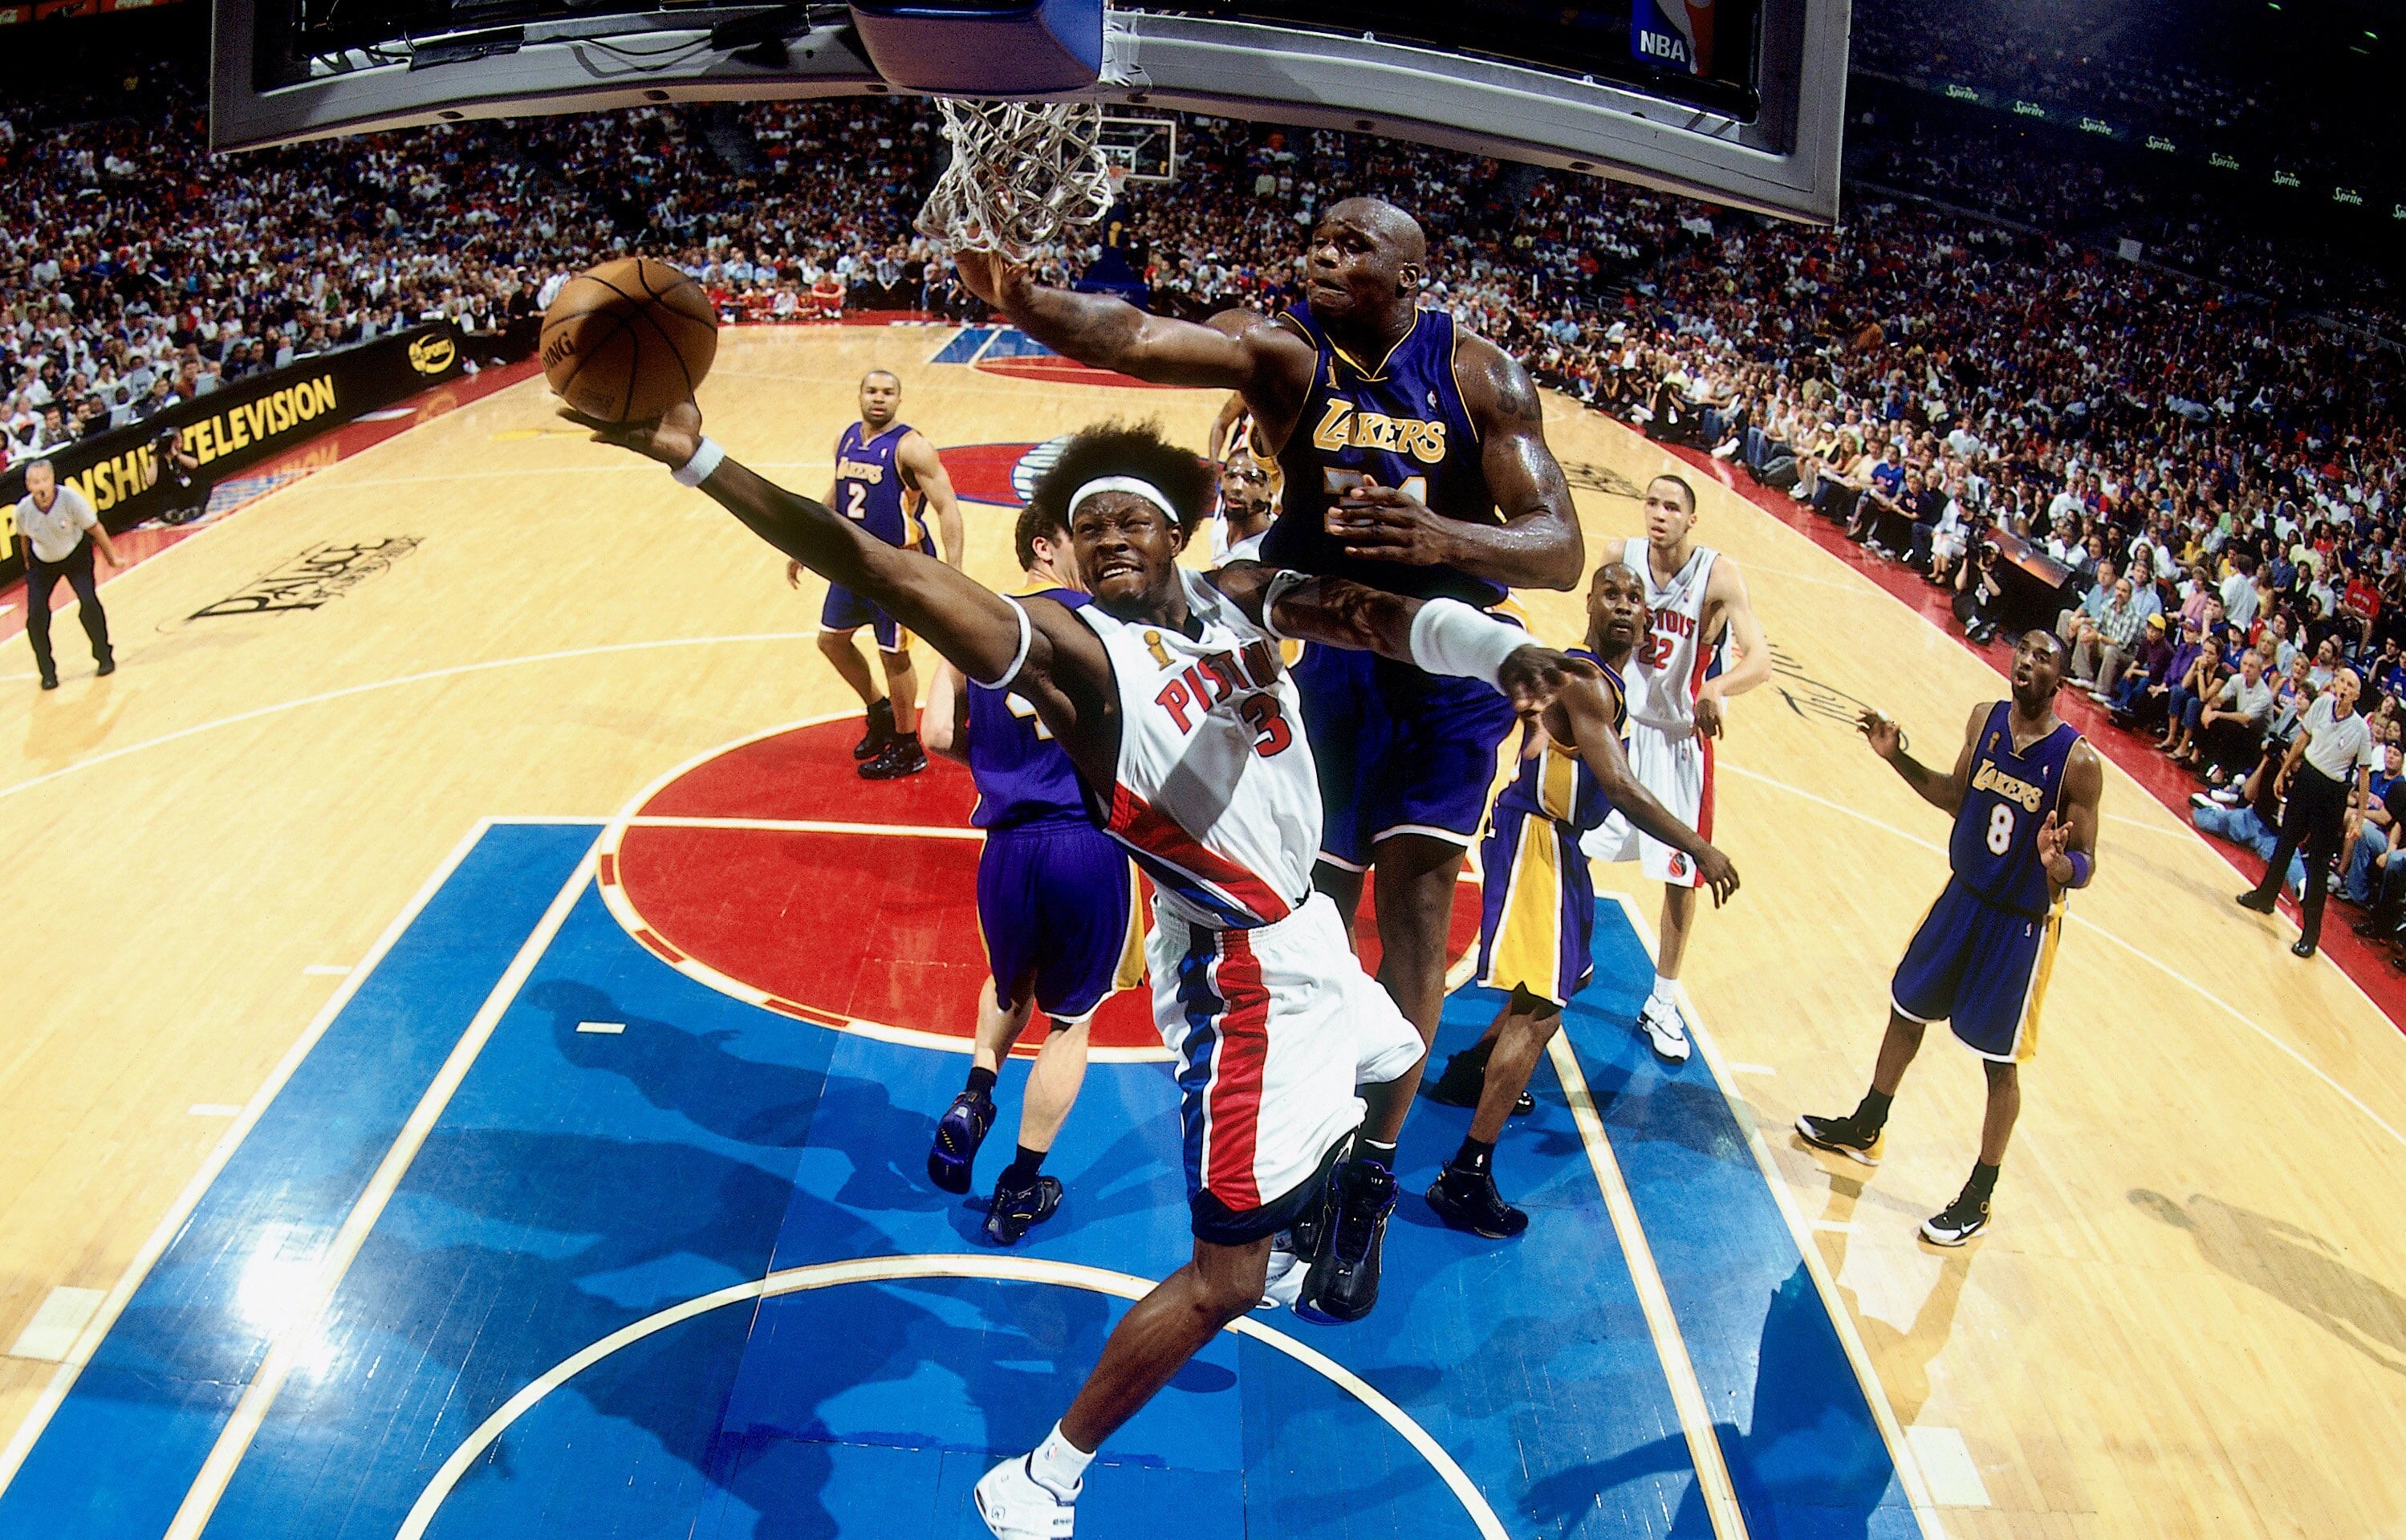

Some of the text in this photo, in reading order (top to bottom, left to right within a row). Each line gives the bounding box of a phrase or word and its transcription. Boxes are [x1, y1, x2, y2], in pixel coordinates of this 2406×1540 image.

[1640, 30, 1685, 62] NBA
[1945, 84, 1979, 101] Sprite
[2013, 100, 2045, 117] Sprite
[2079, 117, 2112, 135] Sprite
[2145, 136, 2176, 152] Sprite
[2209, 152, 2240, 170] Sprite
[2272, 170, 2301, 188] Sprite
[2332, 186, 2363, 205] Sprite
[182, 374, 337, 465] TELEVISION
[1313, 398, 1445, 463] LAKERS
[847, 482, 867, 520] 2
[1639, 632, 1674, 670] 22
[1241, 693, 1292, 758] 3
[1972, 758, 2044, 813] LAKERS
[1986, 803, 2016, 856] 8
